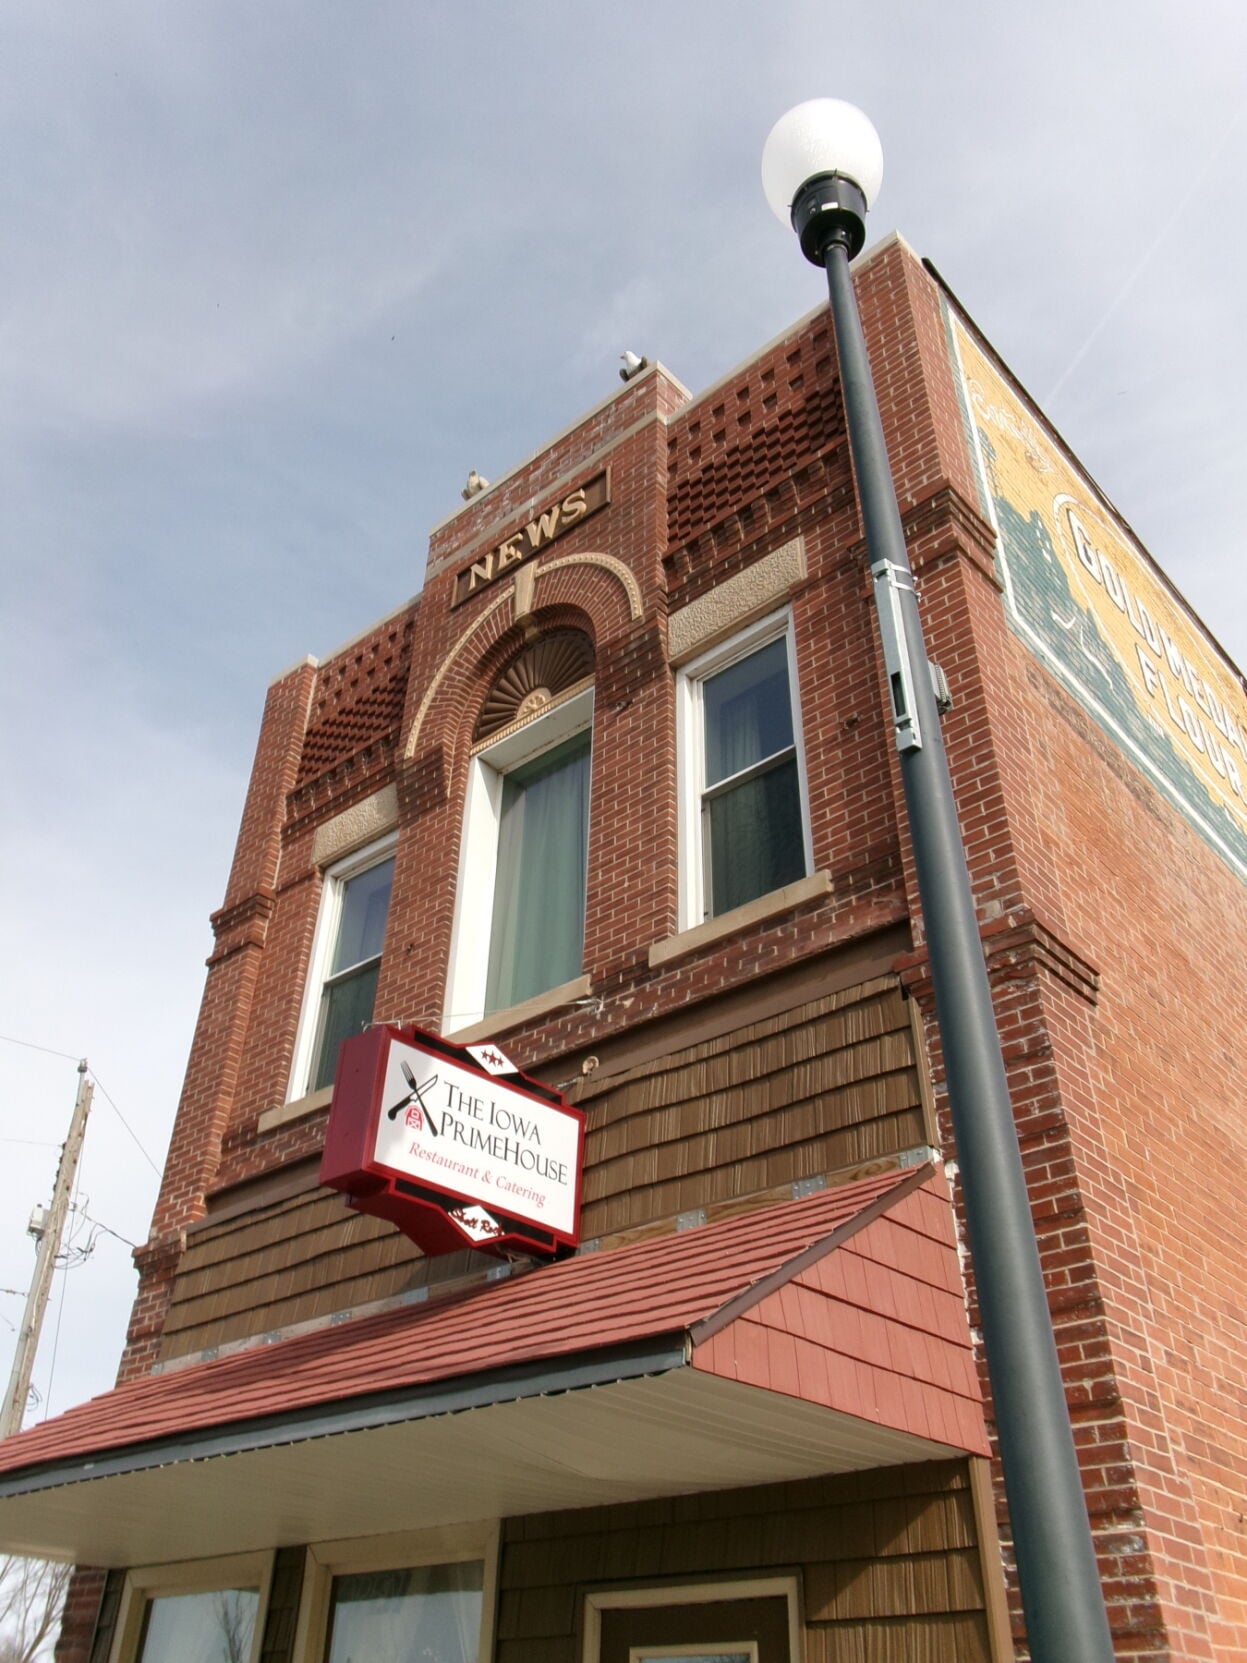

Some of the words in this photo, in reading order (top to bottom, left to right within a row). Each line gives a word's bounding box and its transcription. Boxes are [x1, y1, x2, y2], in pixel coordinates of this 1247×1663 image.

[468, 488, 588, 592] NEWS
[1066, 508, 1162, 659] GOLD
[1135, 643, 1247, 808] FLOUR
[444, 1080, 485, 1121] THE
[490, 1101, 541, 1146] IOWA
[408, 1141, 479, 1180] Restaurant
[481, 1169, 492, 1185] &
[496, 1175, 546, 1209] Catering
